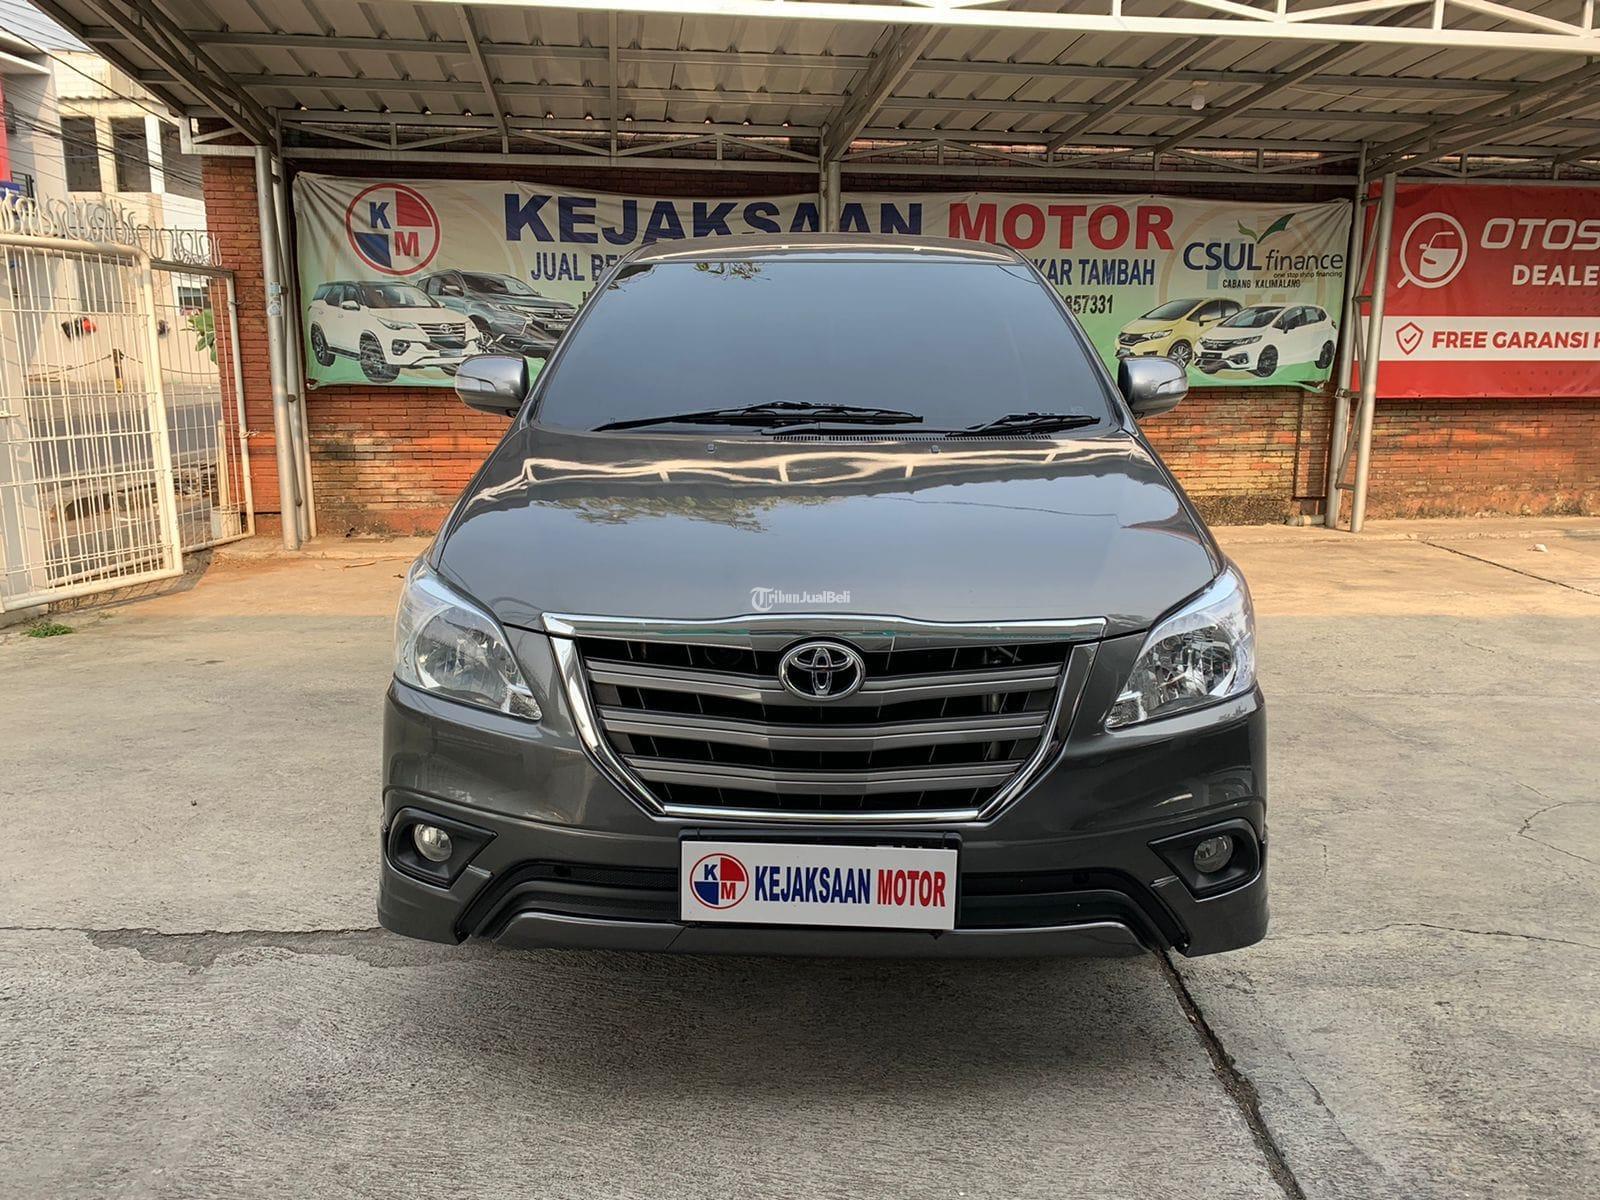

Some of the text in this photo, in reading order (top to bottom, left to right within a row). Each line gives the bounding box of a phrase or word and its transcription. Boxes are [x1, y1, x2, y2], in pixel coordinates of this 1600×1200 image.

[504, 193, 1174, 250] KEJAKSAAN MOTOR
[1480, 218, 1600, 250] OTOS
[531, 252, 585, 281] JUAL
[1183, 242, 1344, 271] CSUL finance
[1078, 258, 1155, 286] TAMBAH
[1223, 280, 1251, 288] CABANG
[1432, 331, 1488, 348] FREE
[1492, 331, 1589, 349] GARANSI
[755, 866, 946, 907] KEJAKSAAN MOTOR
